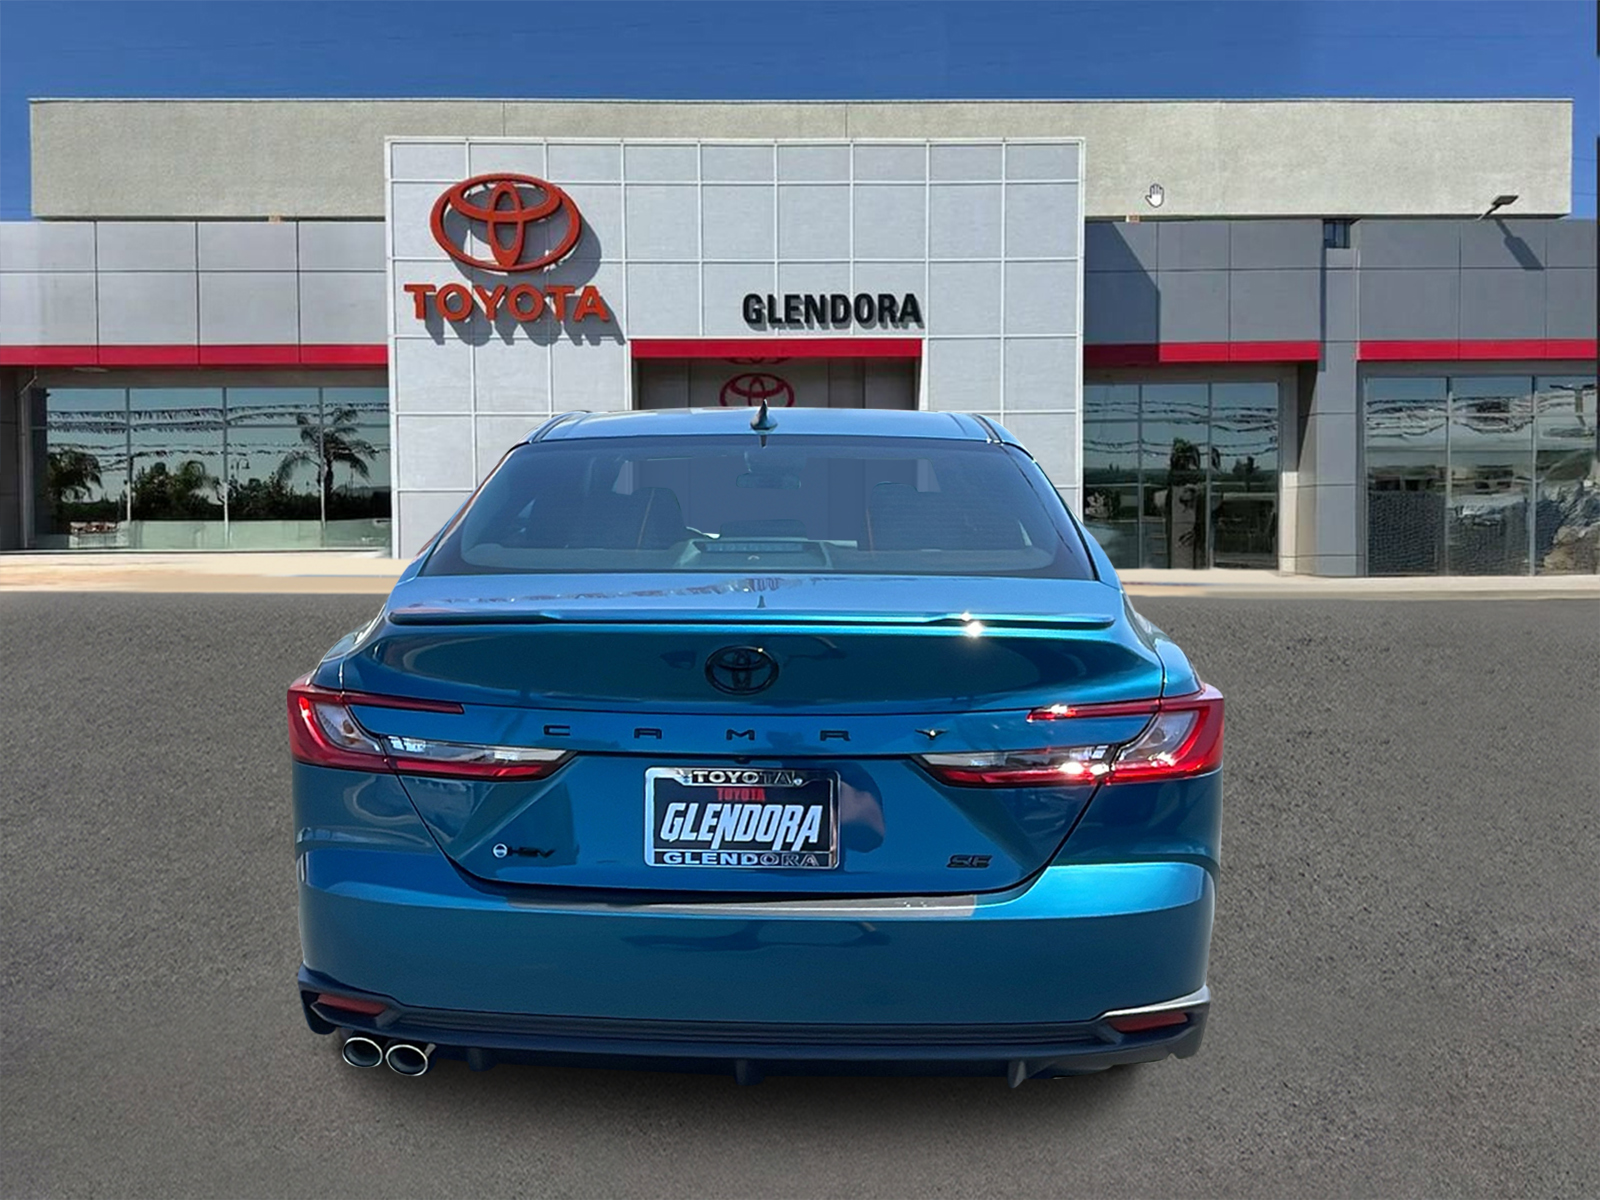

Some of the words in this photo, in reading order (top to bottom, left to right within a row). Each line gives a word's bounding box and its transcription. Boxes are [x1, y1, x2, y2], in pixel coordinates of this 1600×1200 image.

[405, 284, 609, 321] TOYOTA
[743, 293, 922, 325] GLENDORA
[692, 770, 793, 784] TOYOTA
[717, 787, 766, 800] TOYOTA
[660, 802, 823, 851] GLENDORA
[663, 851, 819, 866] GLENDORA
[946, 854, 993, 868] SE
